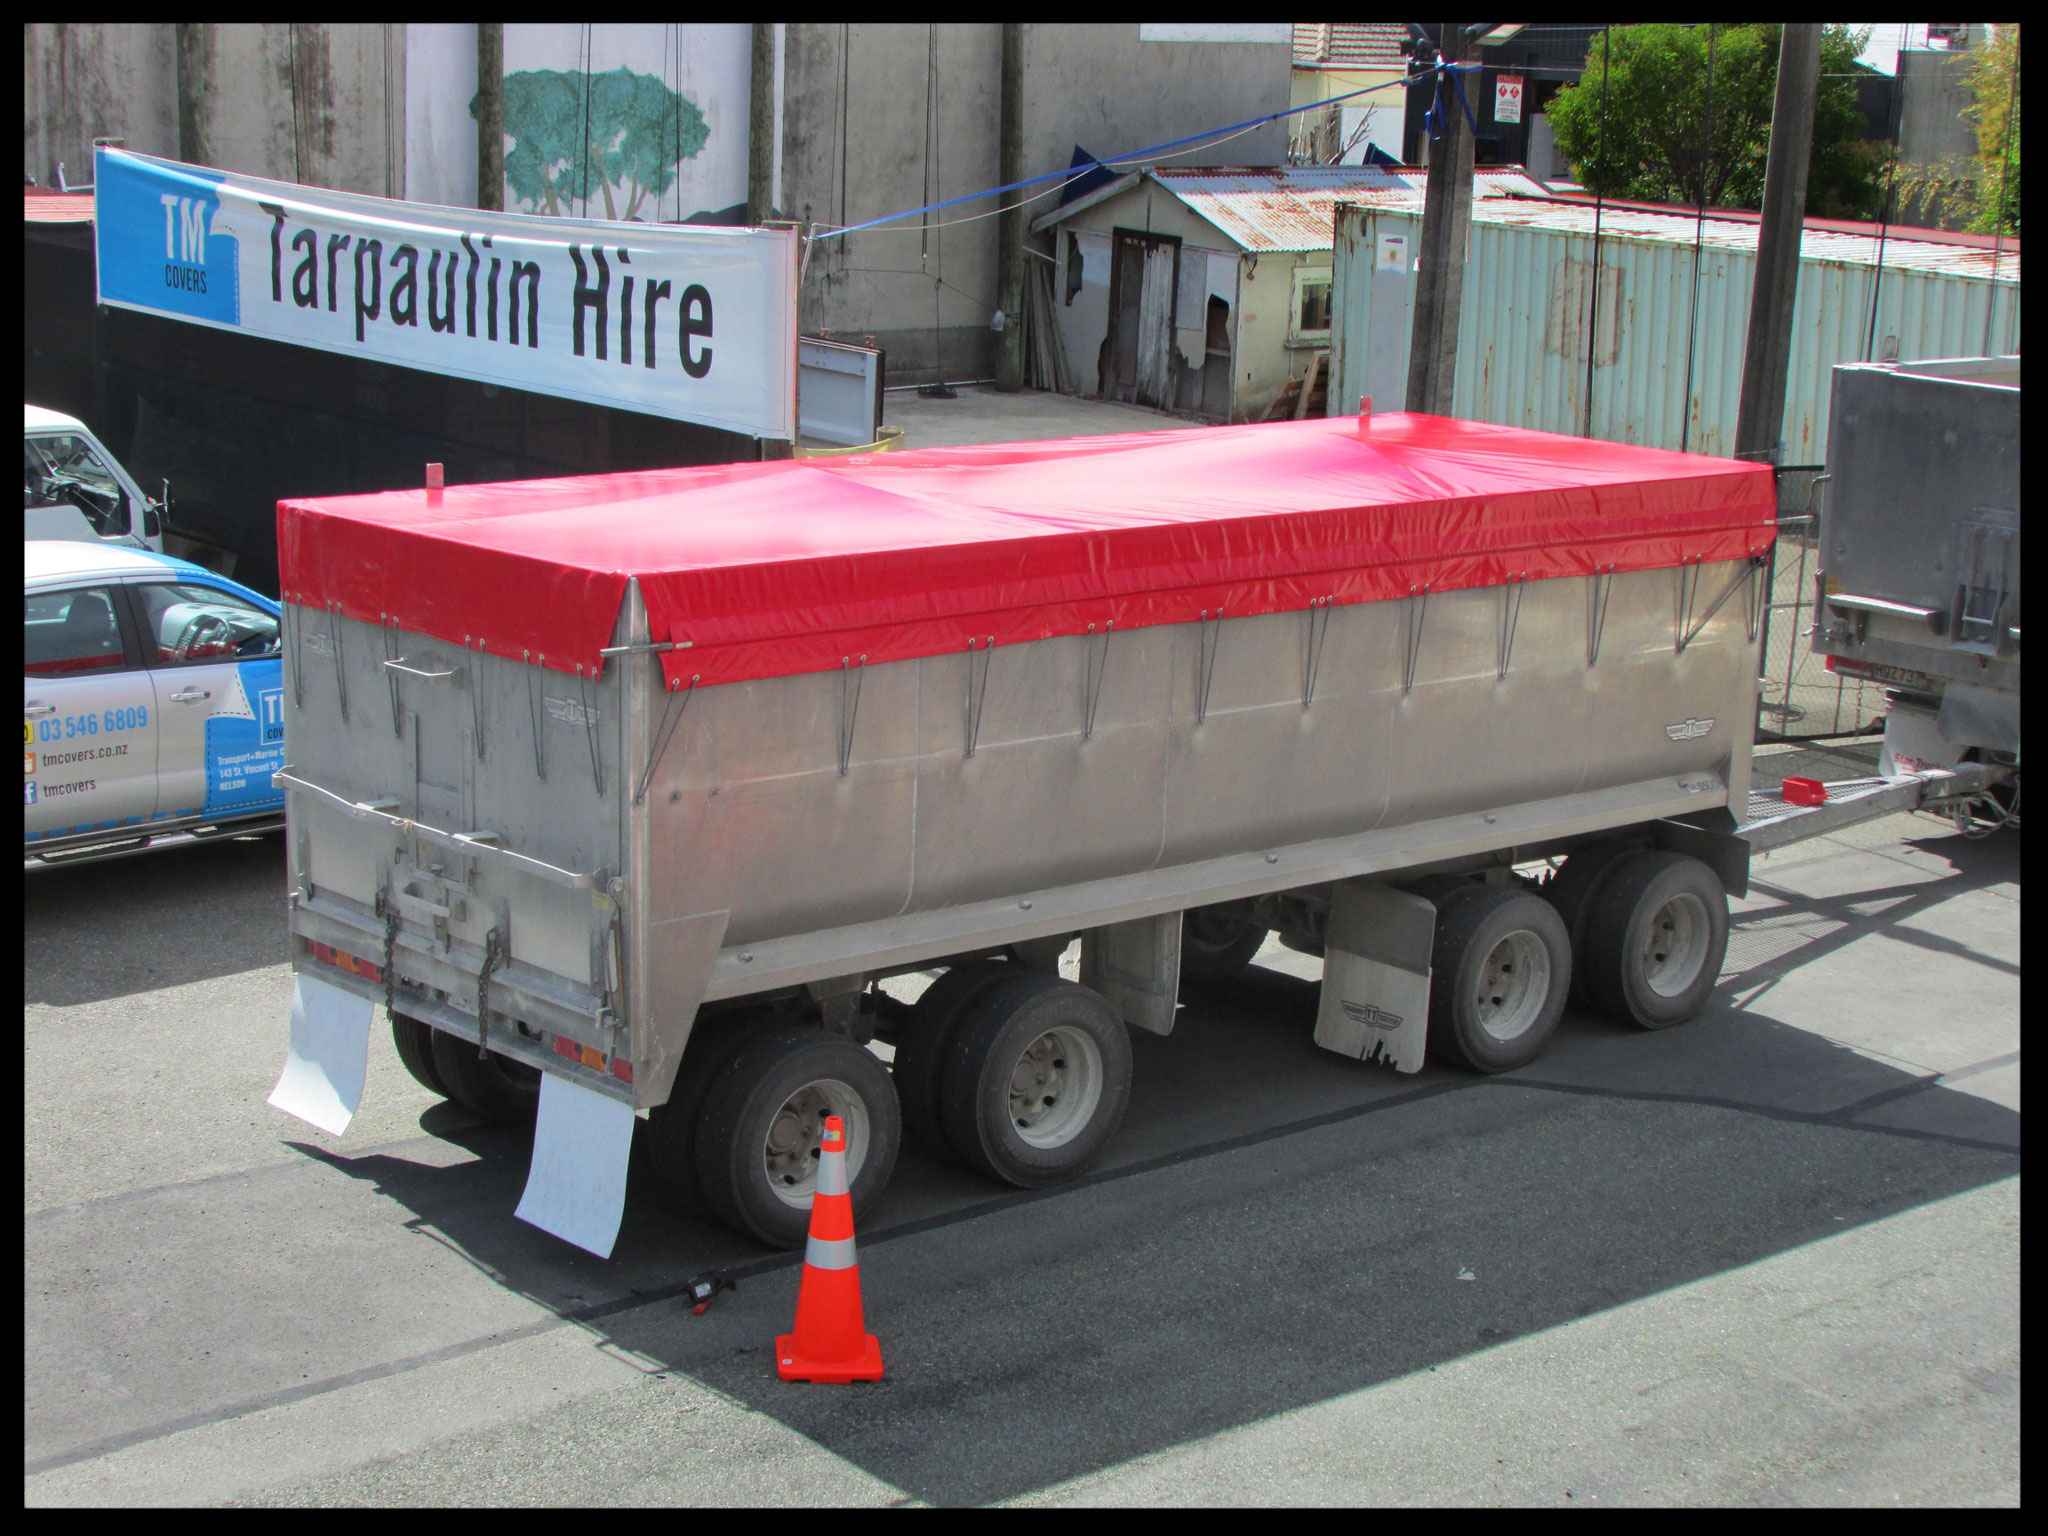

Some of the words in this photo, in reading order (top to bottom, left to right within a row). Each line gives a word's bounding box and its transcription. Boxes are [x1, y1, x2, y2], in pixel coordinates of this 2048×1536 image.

[161, 193, 207, 265] TM
[165, 263, 207, 294] COVERS
[259, 202, 541, 349] Tarpaulin
[569, 243, 713, 379] Hire
[1875, 664, 1916, 683] HQZ73
[40, 718, 62, 741] 03
[65, 713, 98, 738] 546
[104, 705, 148, 732] 6809
[267, 727, 284, 739] COV
[42, 744, 128, 767] tmcovers.co.nz
[1894, 753, 1913, 765] Star
[220, 768, 233, 778] 143
[244, 763, 270, 774] Vincent
[43, 780, 97, 797] tmcovers
[219, 780, 247, 791] NELSON
